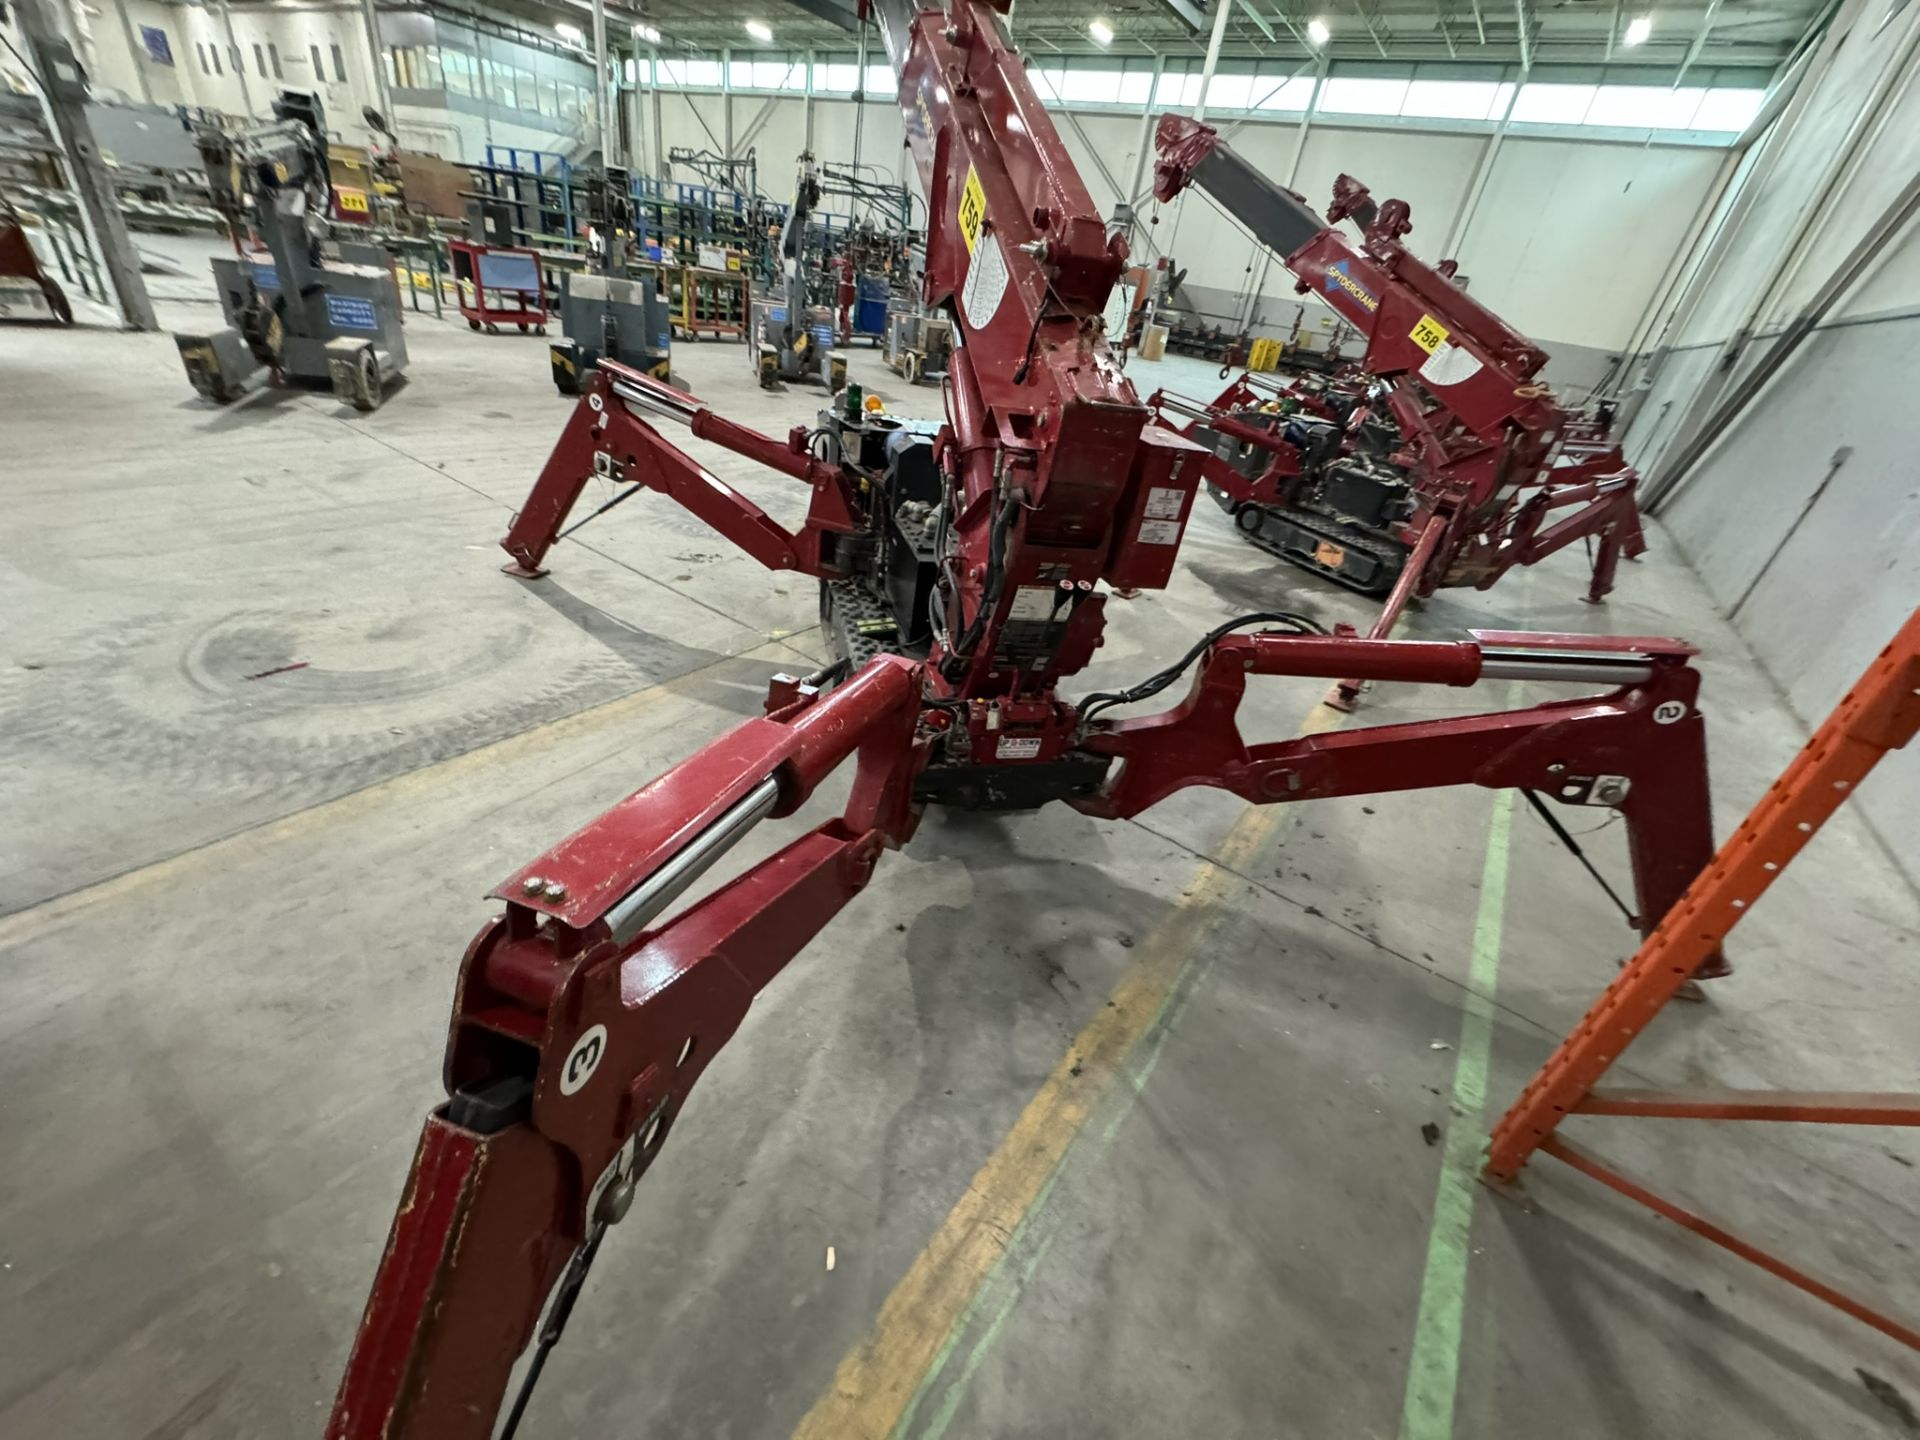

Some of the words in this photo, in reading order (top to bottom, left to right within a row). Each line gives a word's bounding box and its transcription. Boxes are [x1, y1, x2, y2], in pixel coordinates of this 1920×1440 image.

[962, 186, 979, 241] 759
[1328, 266, 1378, 312] SPYDERCRANE
[1415, 324, 1440, 349] 758
[1658, 706, 1680, 720] 2
[568, 1035, 601, 1083] 3
